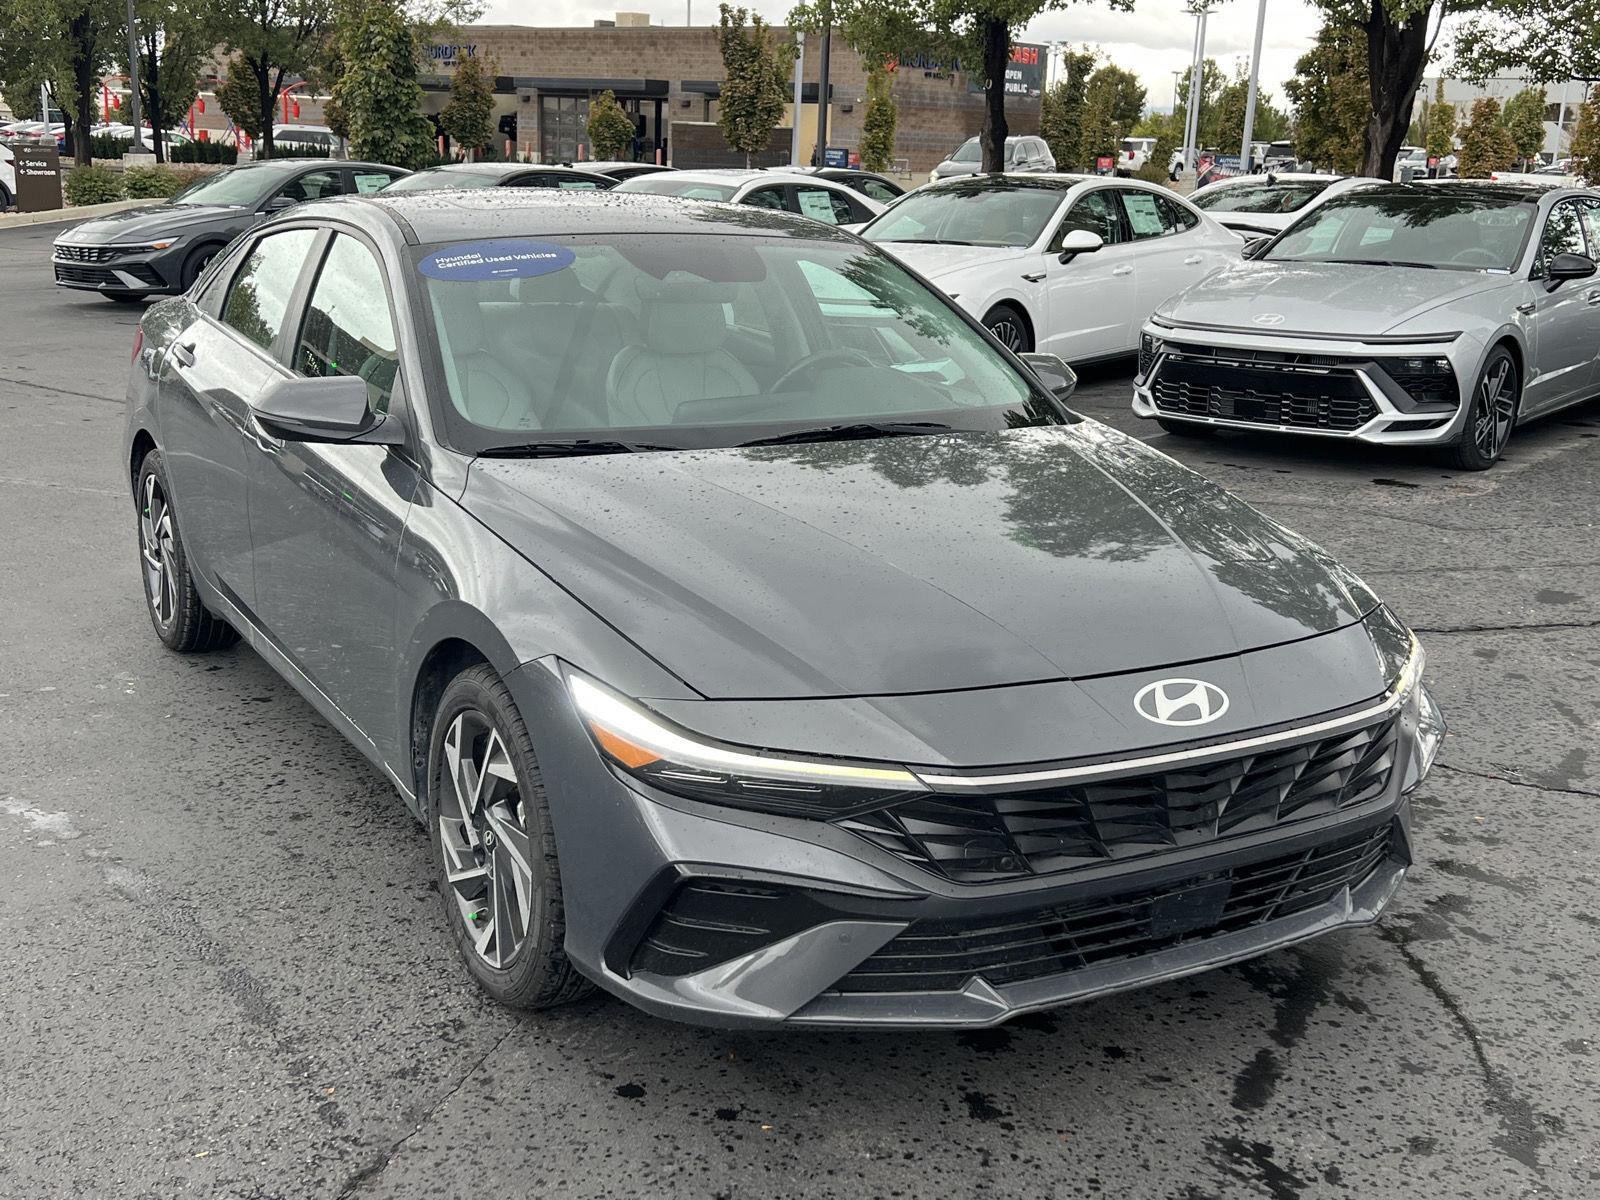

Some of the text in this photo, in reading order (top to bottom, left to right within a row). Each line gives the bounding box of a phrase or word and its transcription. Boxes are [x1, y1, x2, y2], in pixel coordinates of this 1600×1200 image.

[1005, 69, 1022, 80] OPEN
[1004, 83, 1028, 93] PUBLIC
[26, 168, 56, 176] Showroom
[435, 252, 481, 264] Hyundai
[438, 252, 557, 269] Certified Used Vehicles
